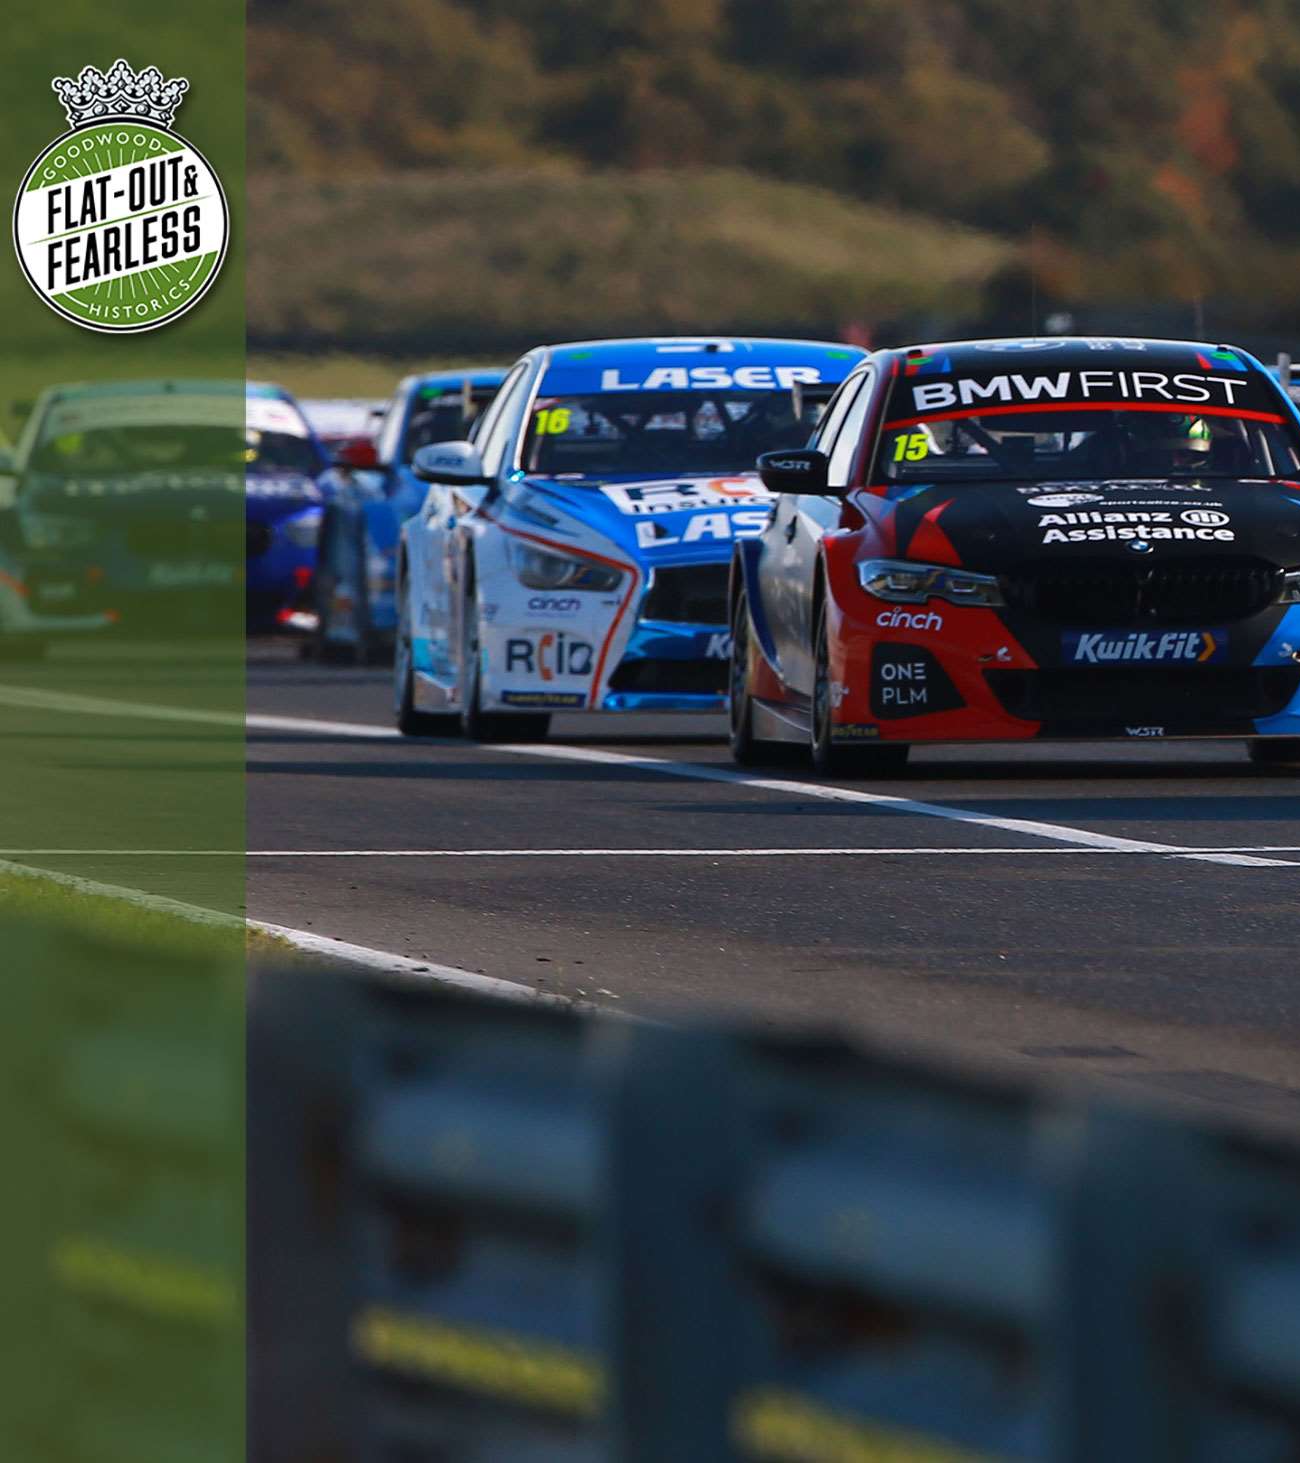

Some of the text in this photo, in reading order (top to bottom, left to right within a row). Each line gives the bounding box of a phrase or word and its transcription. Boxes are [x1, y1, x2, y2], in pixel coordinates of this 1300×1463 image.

[601, 367, 822, 390] LASER
[534, 407, 572, 435] 16
[893, 433, 930, 463] 15
[635, 512, 770, 549] LAS
[1038, 511, 1173, 527] Allianz
[1042, 525, 1236, 544] Assistance
[876, 607, 943, 631] cinch
[881, 662, 927, 681] ONE
[881, 687, 928, 704] PLM
